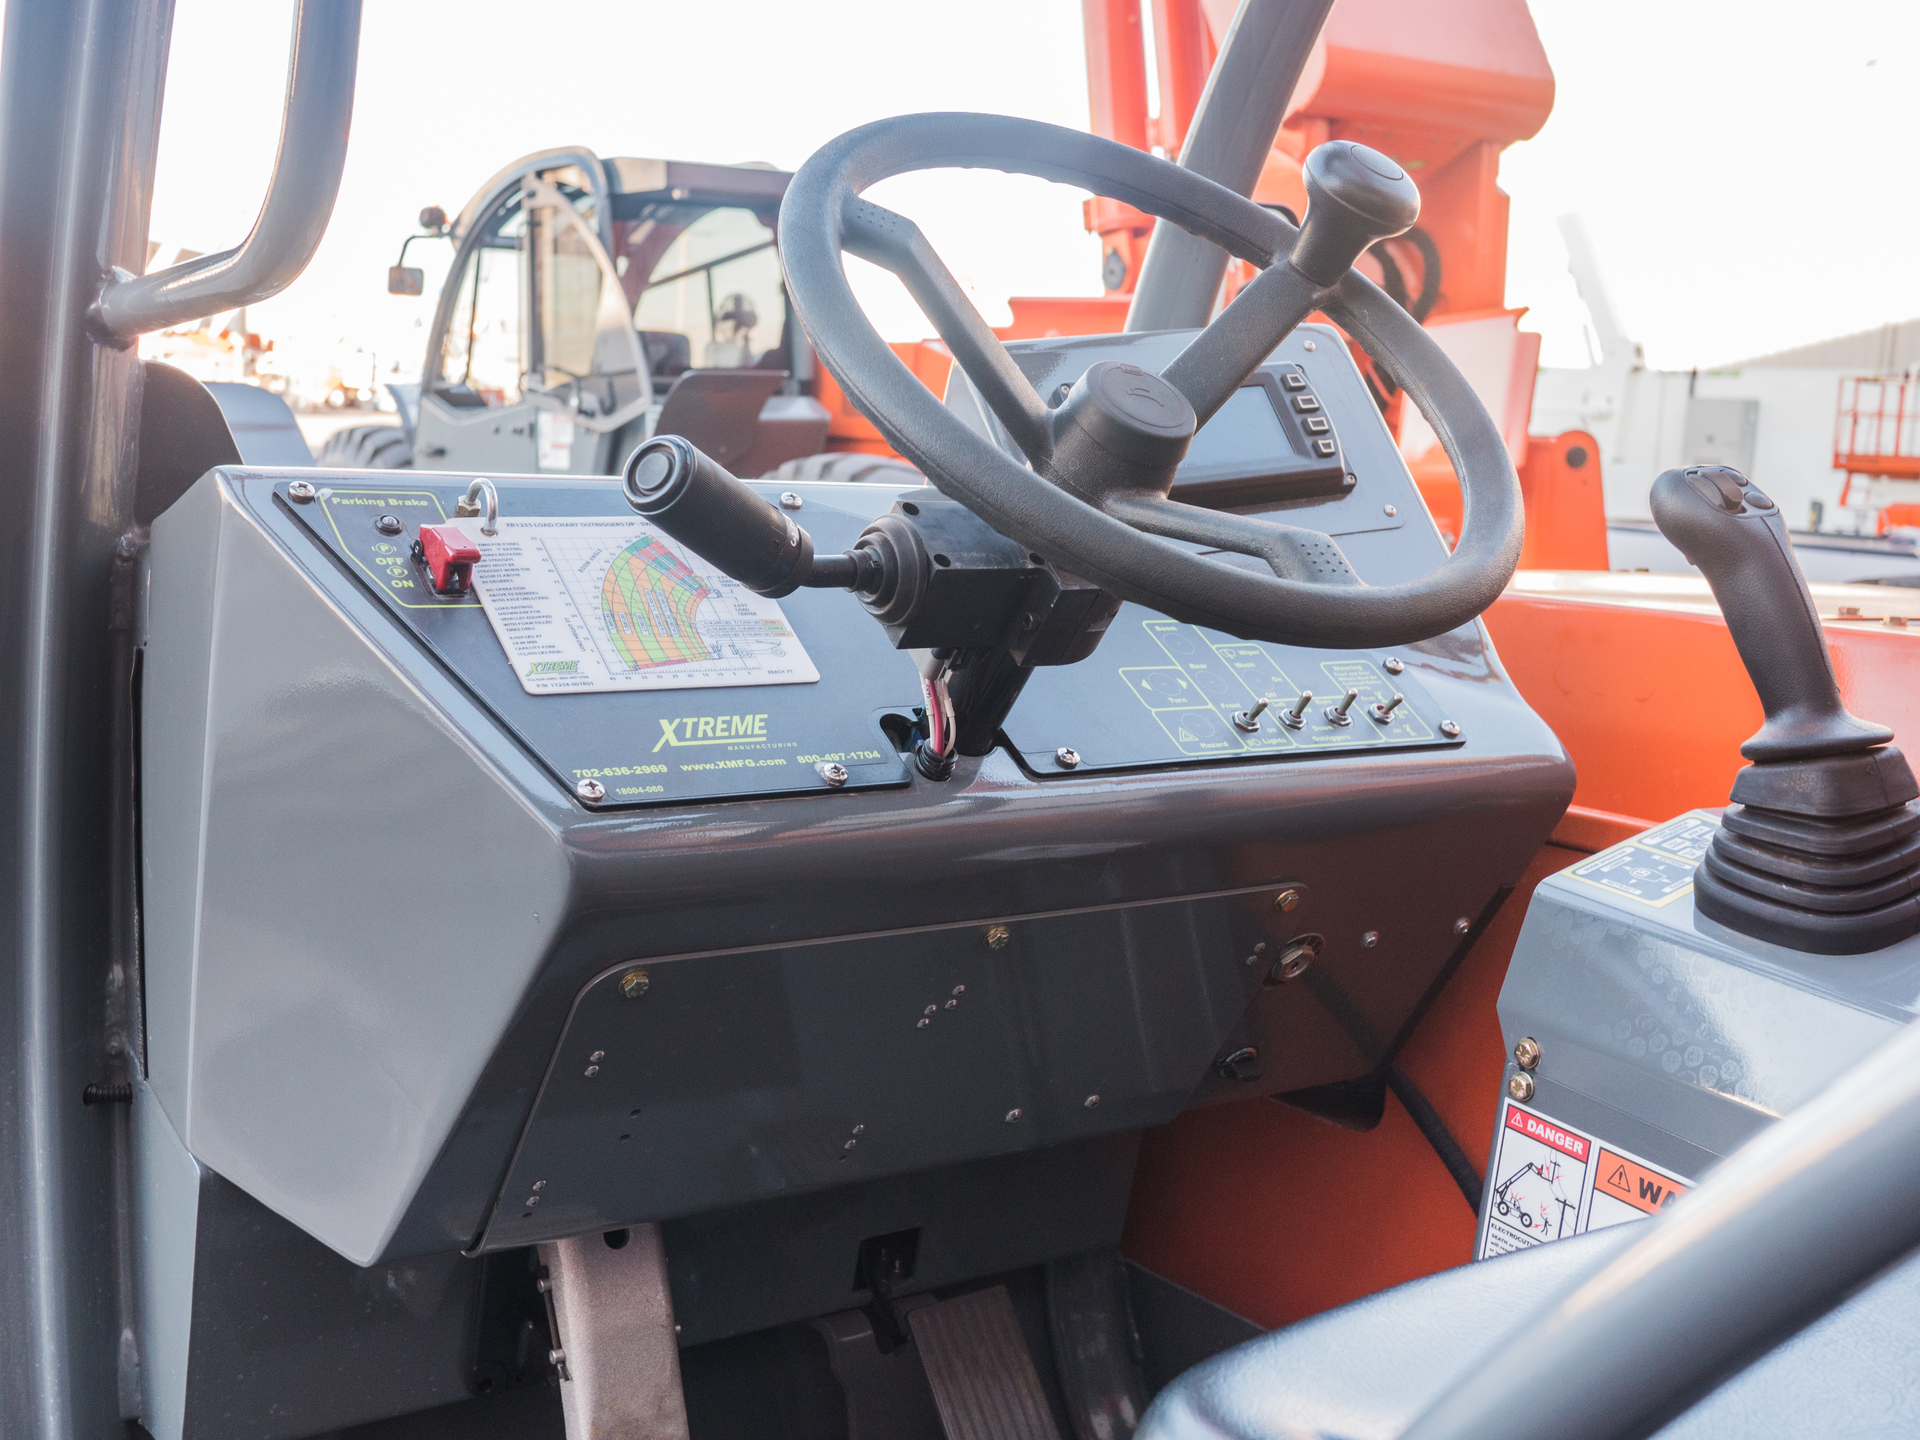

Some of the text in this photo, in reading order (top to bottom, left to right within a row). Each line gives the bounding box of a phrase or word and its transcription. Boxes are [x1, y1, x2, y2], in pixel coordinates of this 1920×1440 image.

[332, 497, 429, 507] Parking Brake
[375, 557, 404, 566] OFF
[578, 548, 603, 573] BOOM ANGLE
[391, 579, 414, 588] ON
[525, 660, 580, 677] XTREME
[652, 714, 768, 752] XTREME
[1312, 734, 1351, 742] Outriggers
[727, 741, 798, 751] MANUFACTURING
[1200, 741, 1229, 749] Hazard
[572, 750, 881, 778] 702-636-2969 www.XMFG.com 800-497-1704
[615, 785, 664, 795] 18004-060
[1526, 1118, 1584, 1156] DANGER
[1491, 1233, 1508, 1245] DEATH
